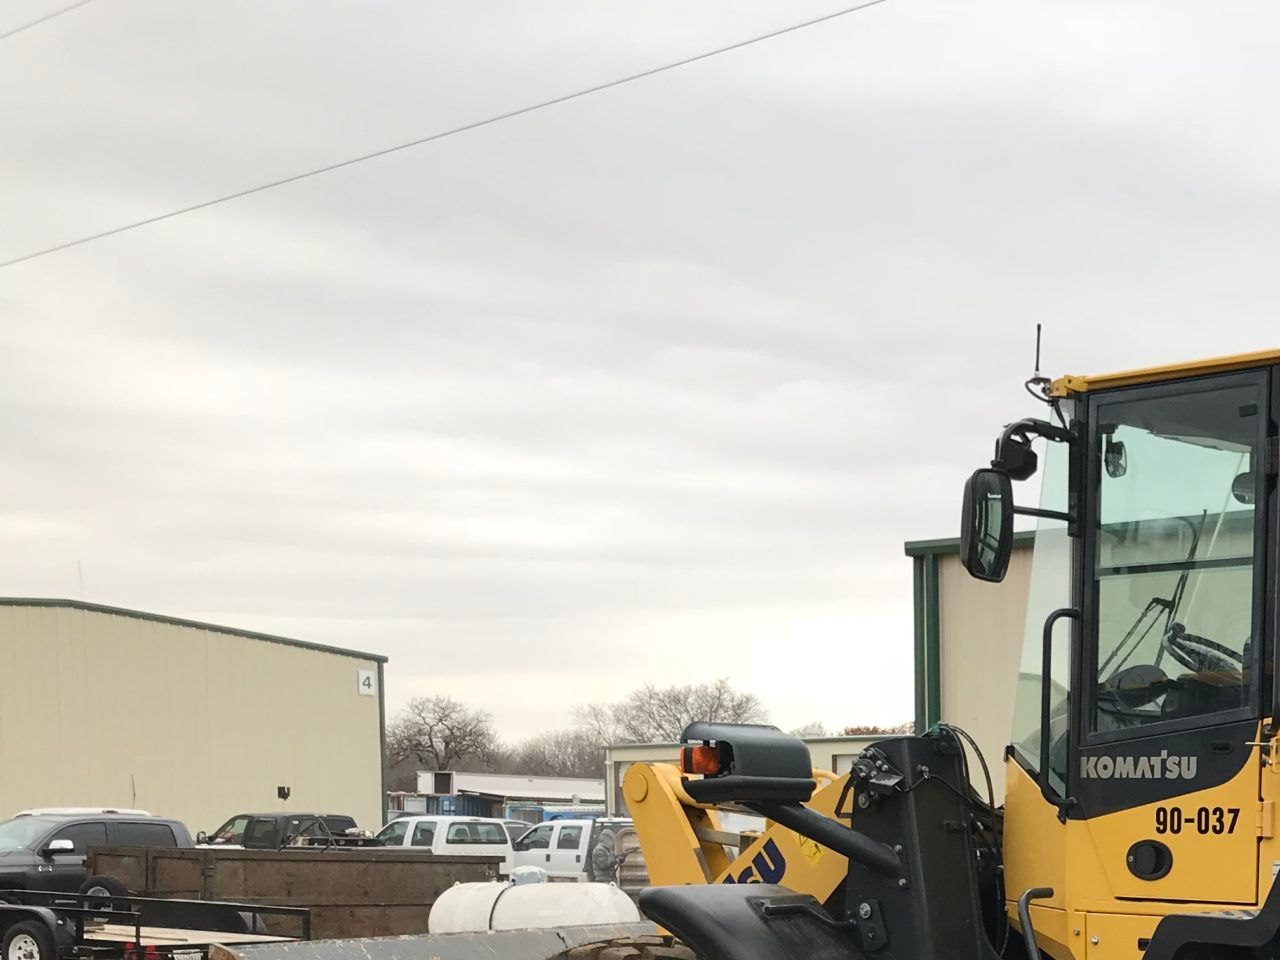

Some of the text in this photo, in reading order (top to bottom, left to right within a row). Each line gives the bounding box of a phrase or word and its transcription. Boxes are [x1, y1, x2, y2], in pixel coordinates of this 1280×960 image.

[362, 676, 373, 689] 4
[1080, 750, 1197, 779] KOMATSU
[1156, 807, 1240, 834] 90-037
